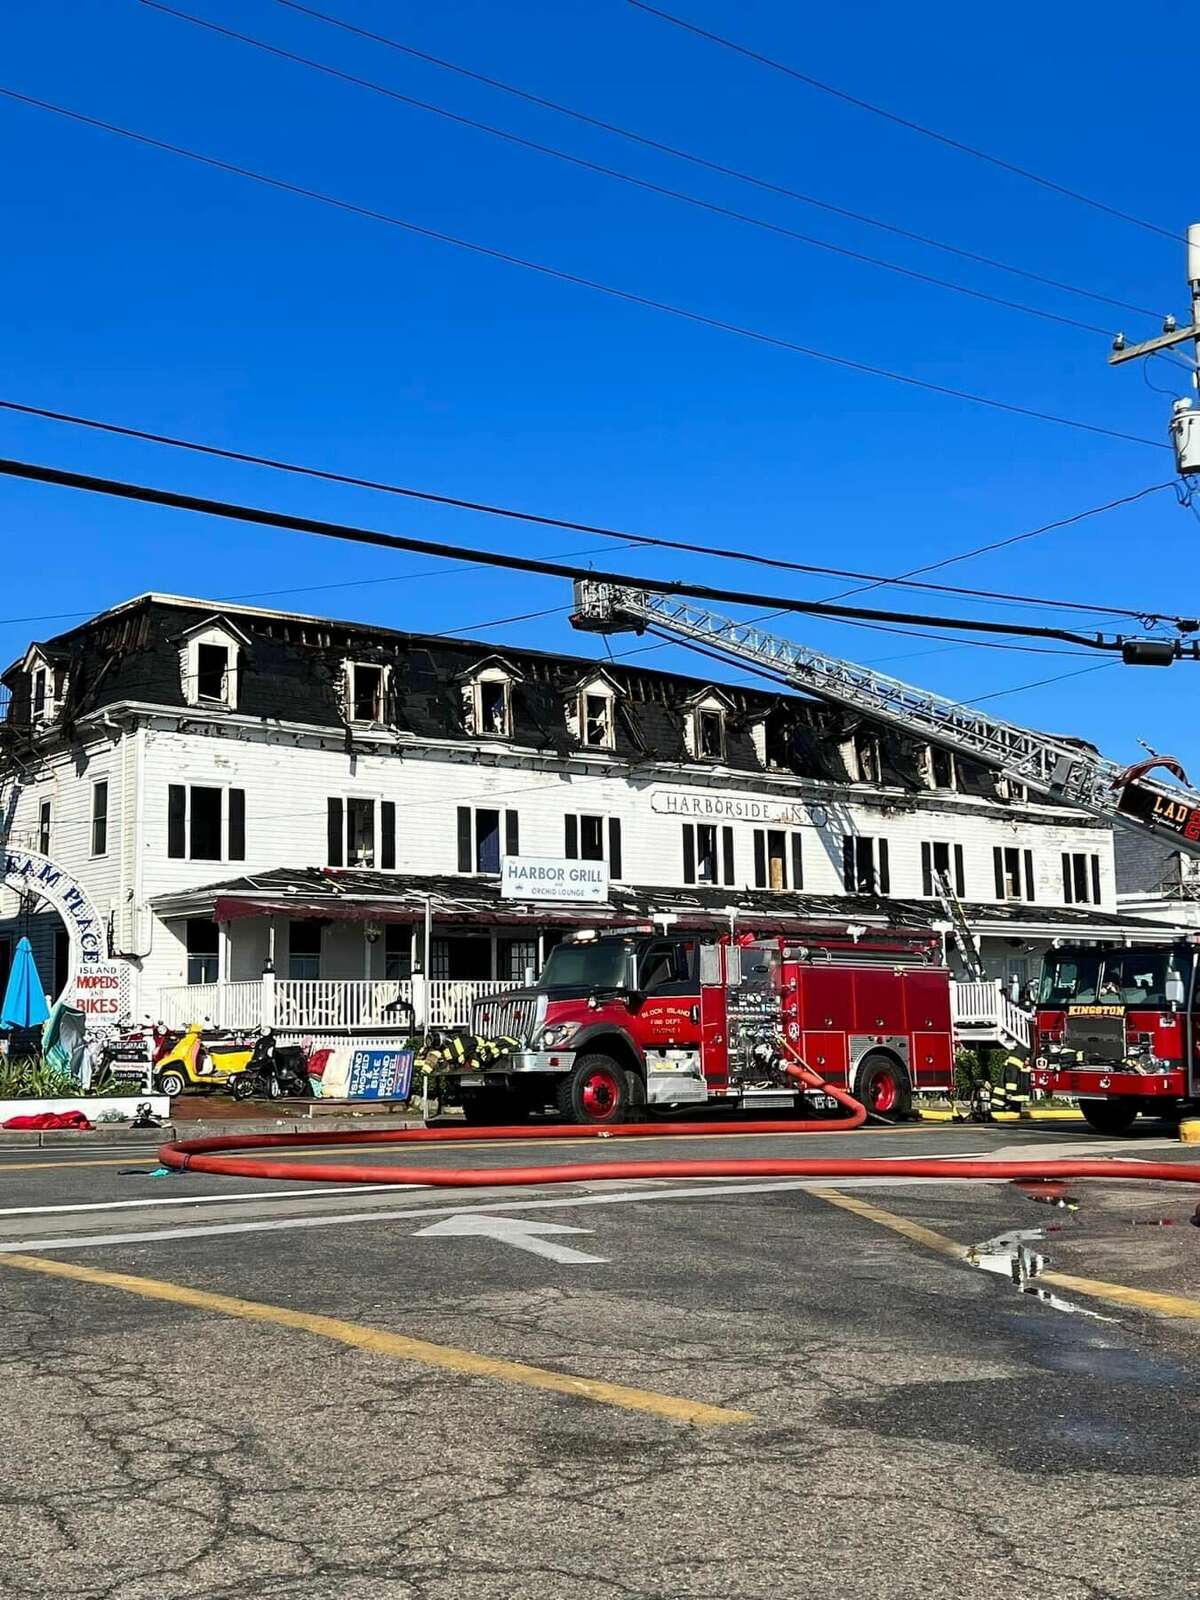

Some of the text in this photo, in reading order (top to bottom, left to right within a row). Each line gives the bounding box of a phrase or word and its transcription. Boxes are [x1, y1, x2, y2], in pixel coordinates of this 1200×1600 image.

[667, 795, 770, 819] HARBORSIDE
[1153, 796, 1188, 823] LAD
[508, 865, 602, 882] HARBOR GRILL
[531, 887, 557, 895] ORCHID
[62, 887, 99, 963] PLACE
[77, 976, 119, 989] MOPEDS
[76, 999, 118, 1013] BIKES
[641, 1007, 690, 1018] BLOCK ISLAND
[1068, 1005, 1125, 1016] KINGSTON
[349, 1053, 363, 1095] ISLAND
[357, 1054, 370, 1094] MOPED
[370, 1058, 382, 1089] BIKE
[378, 1055, 390, 1096] BEHIND
[384, 1055, 397, 1096] HOTEL
